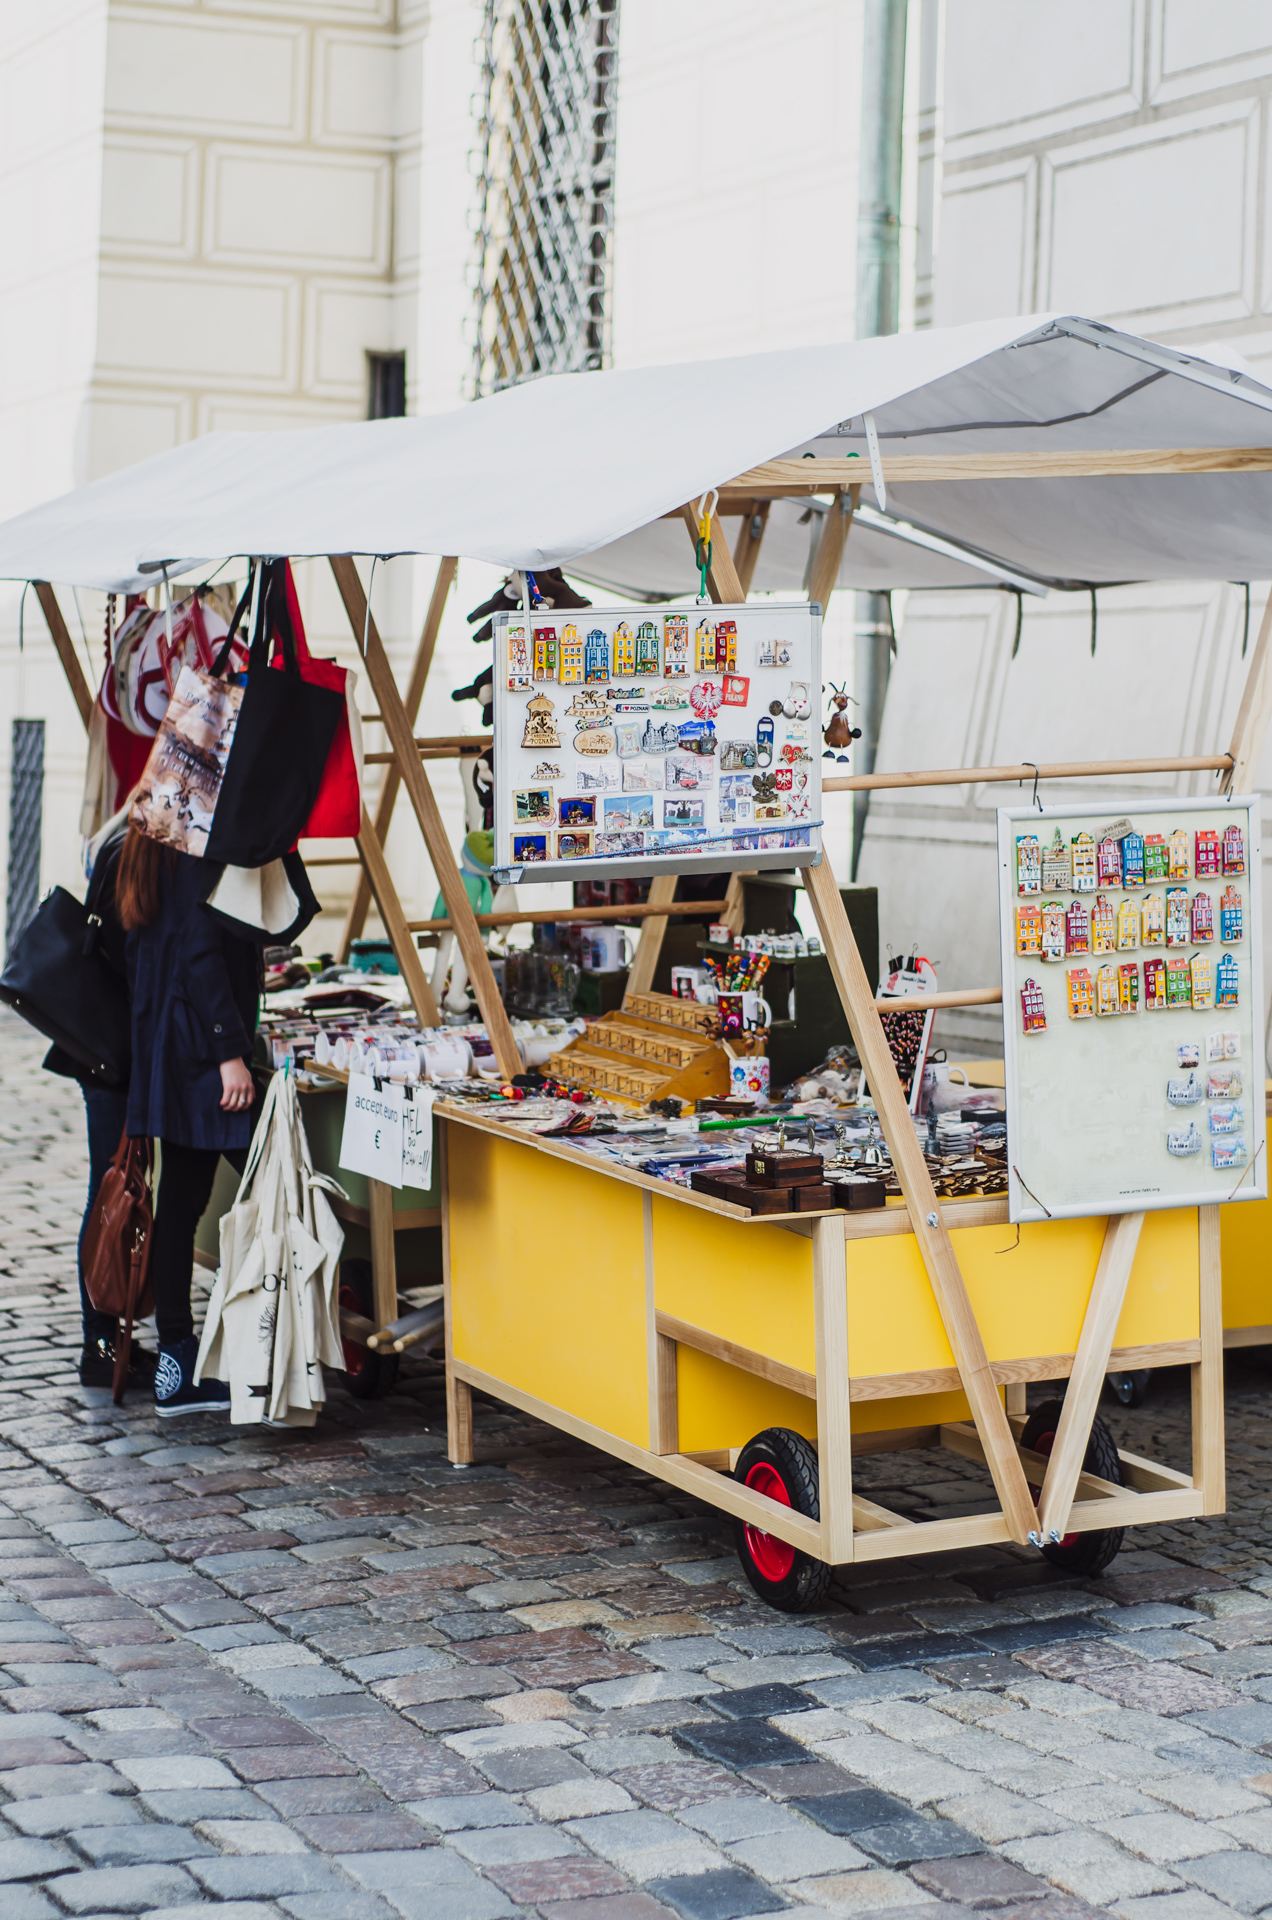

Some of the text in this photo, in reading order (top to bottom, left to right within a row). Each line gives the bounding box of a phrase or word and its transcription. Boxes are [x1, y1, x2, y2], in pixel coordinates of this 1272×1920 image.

[725, 693, 745, 703] POLAND
[355, 1096, 398, 1123] accept euro
[374, 1129, 382, 1150] €
